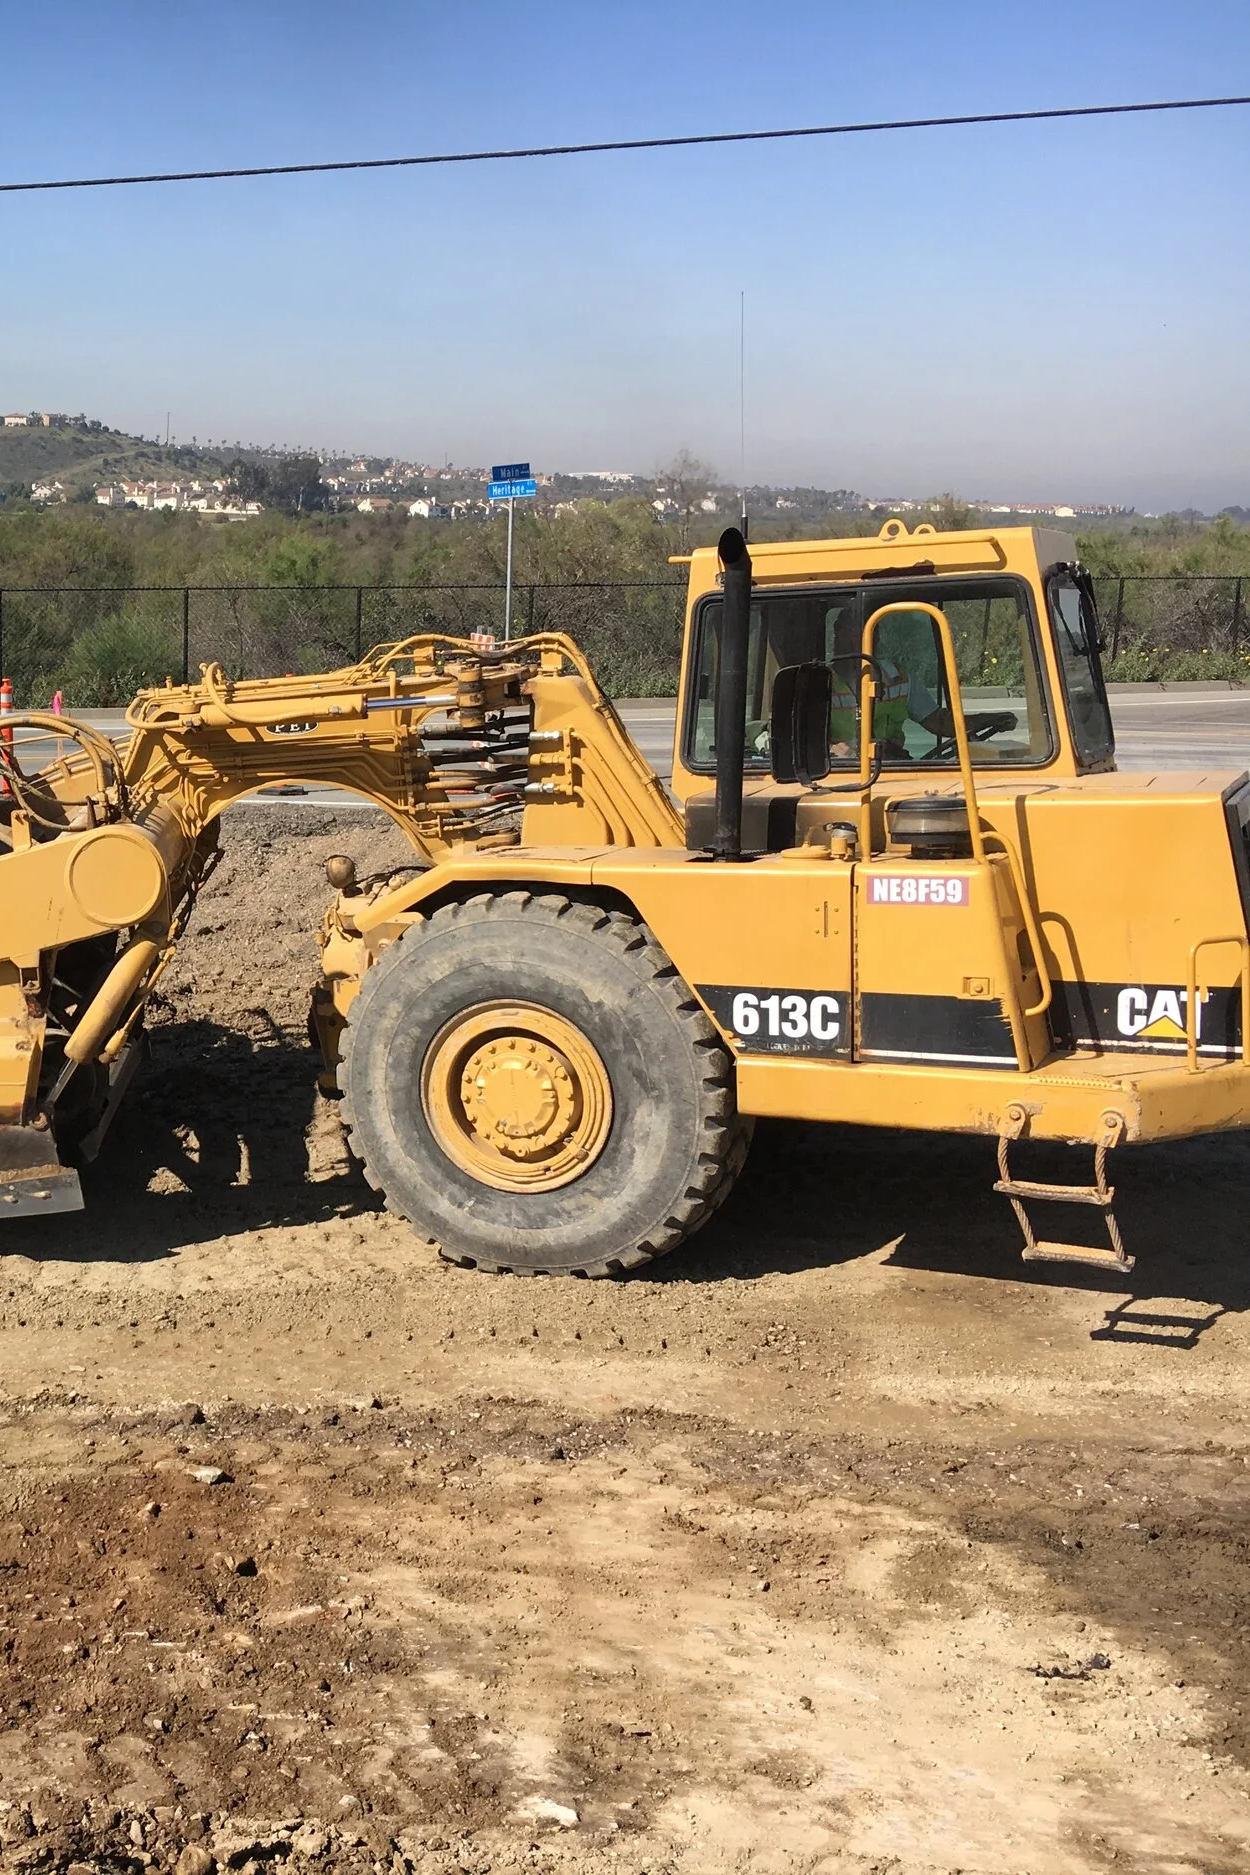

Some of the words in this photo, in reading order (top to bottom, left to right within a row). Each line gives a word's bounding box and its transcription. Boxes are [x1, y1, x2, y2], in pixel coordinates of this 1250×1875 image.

[500, 468, 520, 479] Main
[492, 484, 525, 496] Heritage
[873, 878, 963, 903] NE8F59
[732, 992, 840, 1040] 613C
